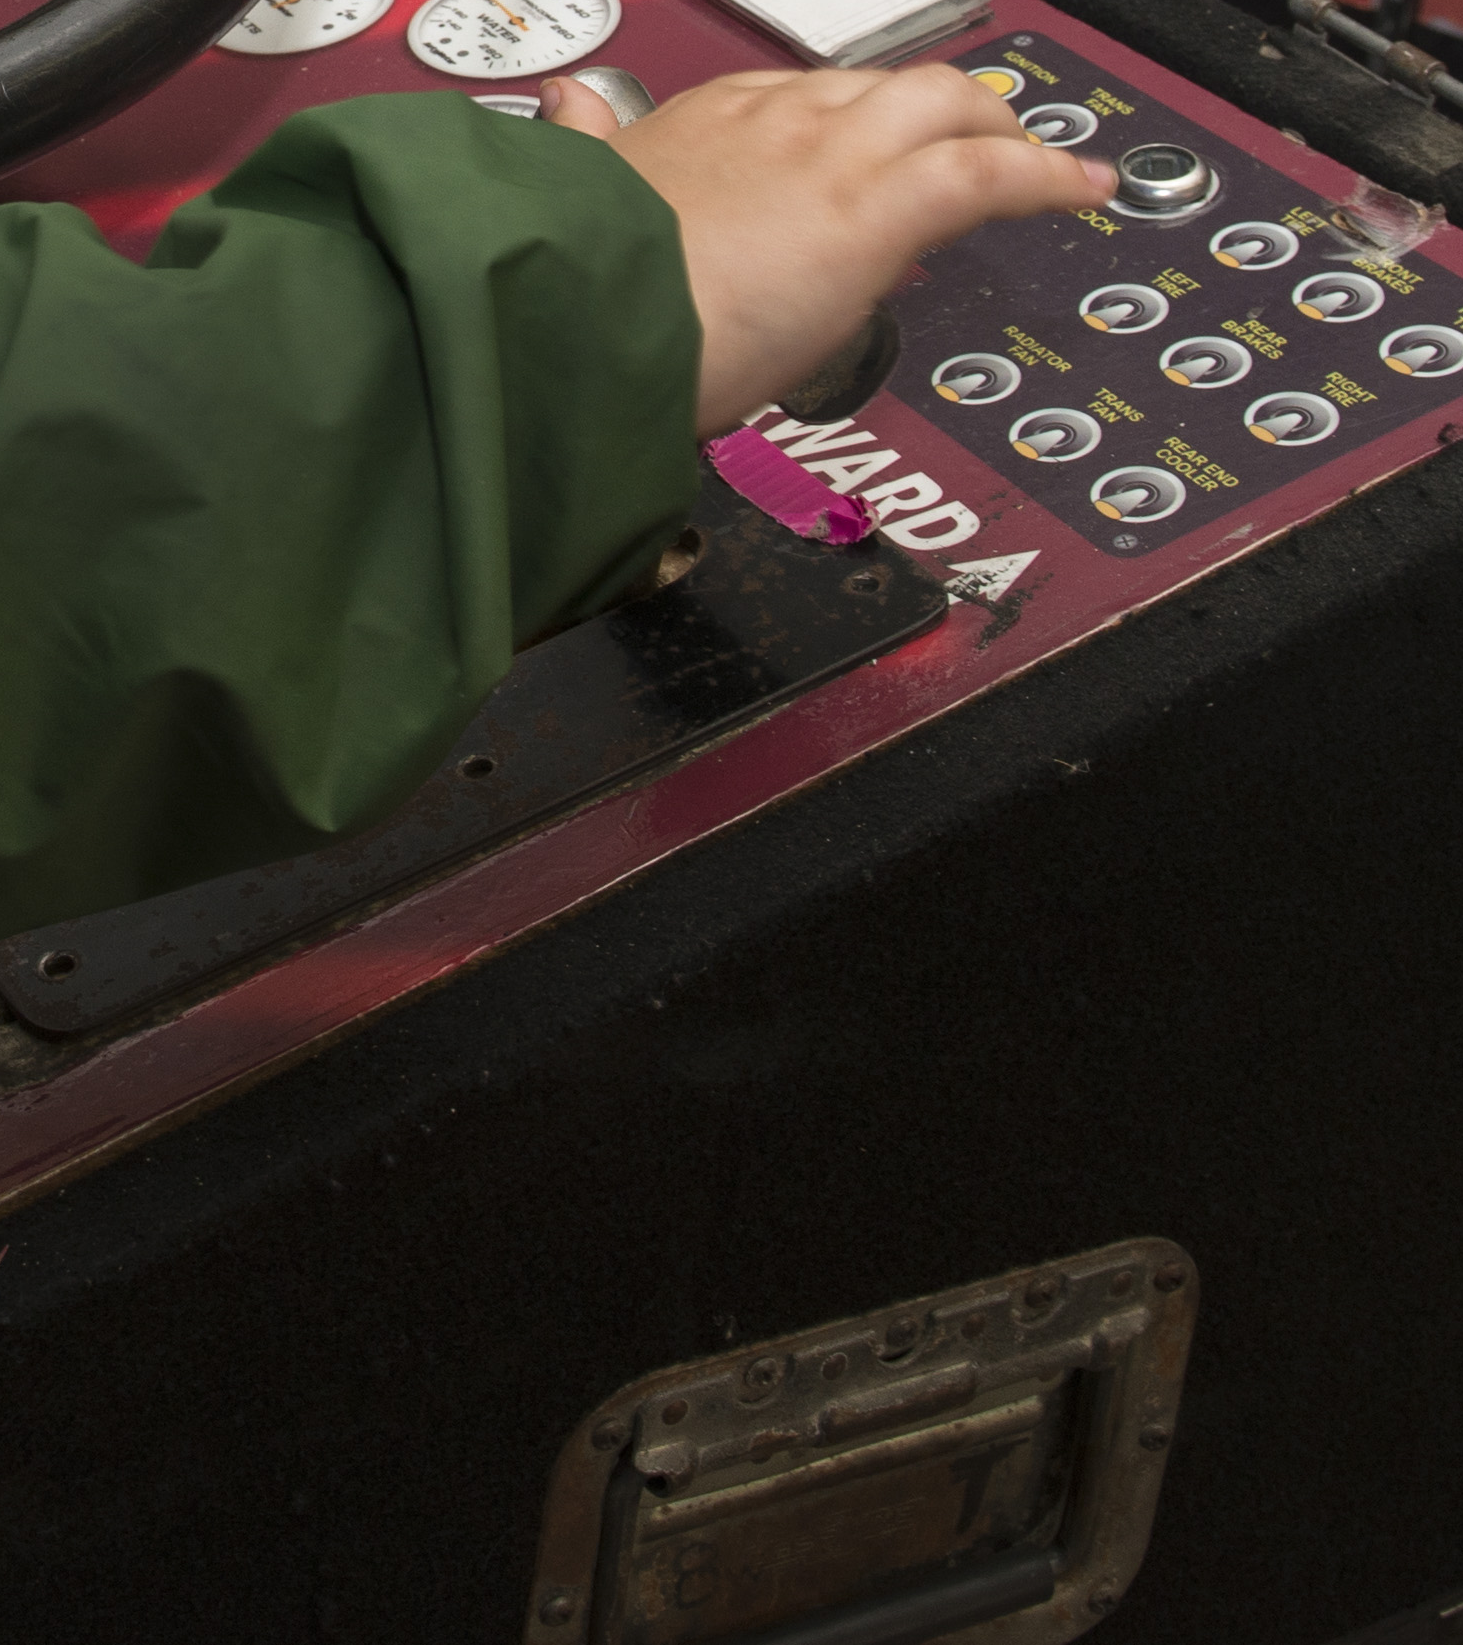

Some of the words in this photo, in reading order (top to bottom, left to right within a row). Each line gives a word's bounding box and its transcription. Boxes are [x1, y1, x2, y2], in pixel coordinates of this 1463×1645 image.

[477, 13, 522, 44] WATER
[1002, 50, 1061, 86] IGNITION
[1084, 98, 1114, 117] FAN
[1090, 87, 1136, 116] TRANS
[1070, 208, 1123, 236] OCK
[1289, 206, 1330, 229] LEFT
[1161, 267, 1202, 291] LEFT
[1351, 258, 1416, 295] BRAKES
[1379, 257, 1425, 284] RONT
[1151, 275, 1187, 299] TIRE
[1220, 320, 1284, 360] BRAKES
[1243, 319, 1288, 348] REAR
[1002, 325, 1073, 373] RADIATOR
[1007, 345, 1040, 366] FAN
[1319, 382, 1359, 408] TIRE
[1325, 371, 1378, 403] RIGHT
[1087, 401, 1121, 423] FAN
[1094, 387, 1145, 422] TRANS
[1156, 448, 1219, 492] COOLER
[1164, 436, 1209, 467] REAR
[1202, 463, 1240, 487] END
